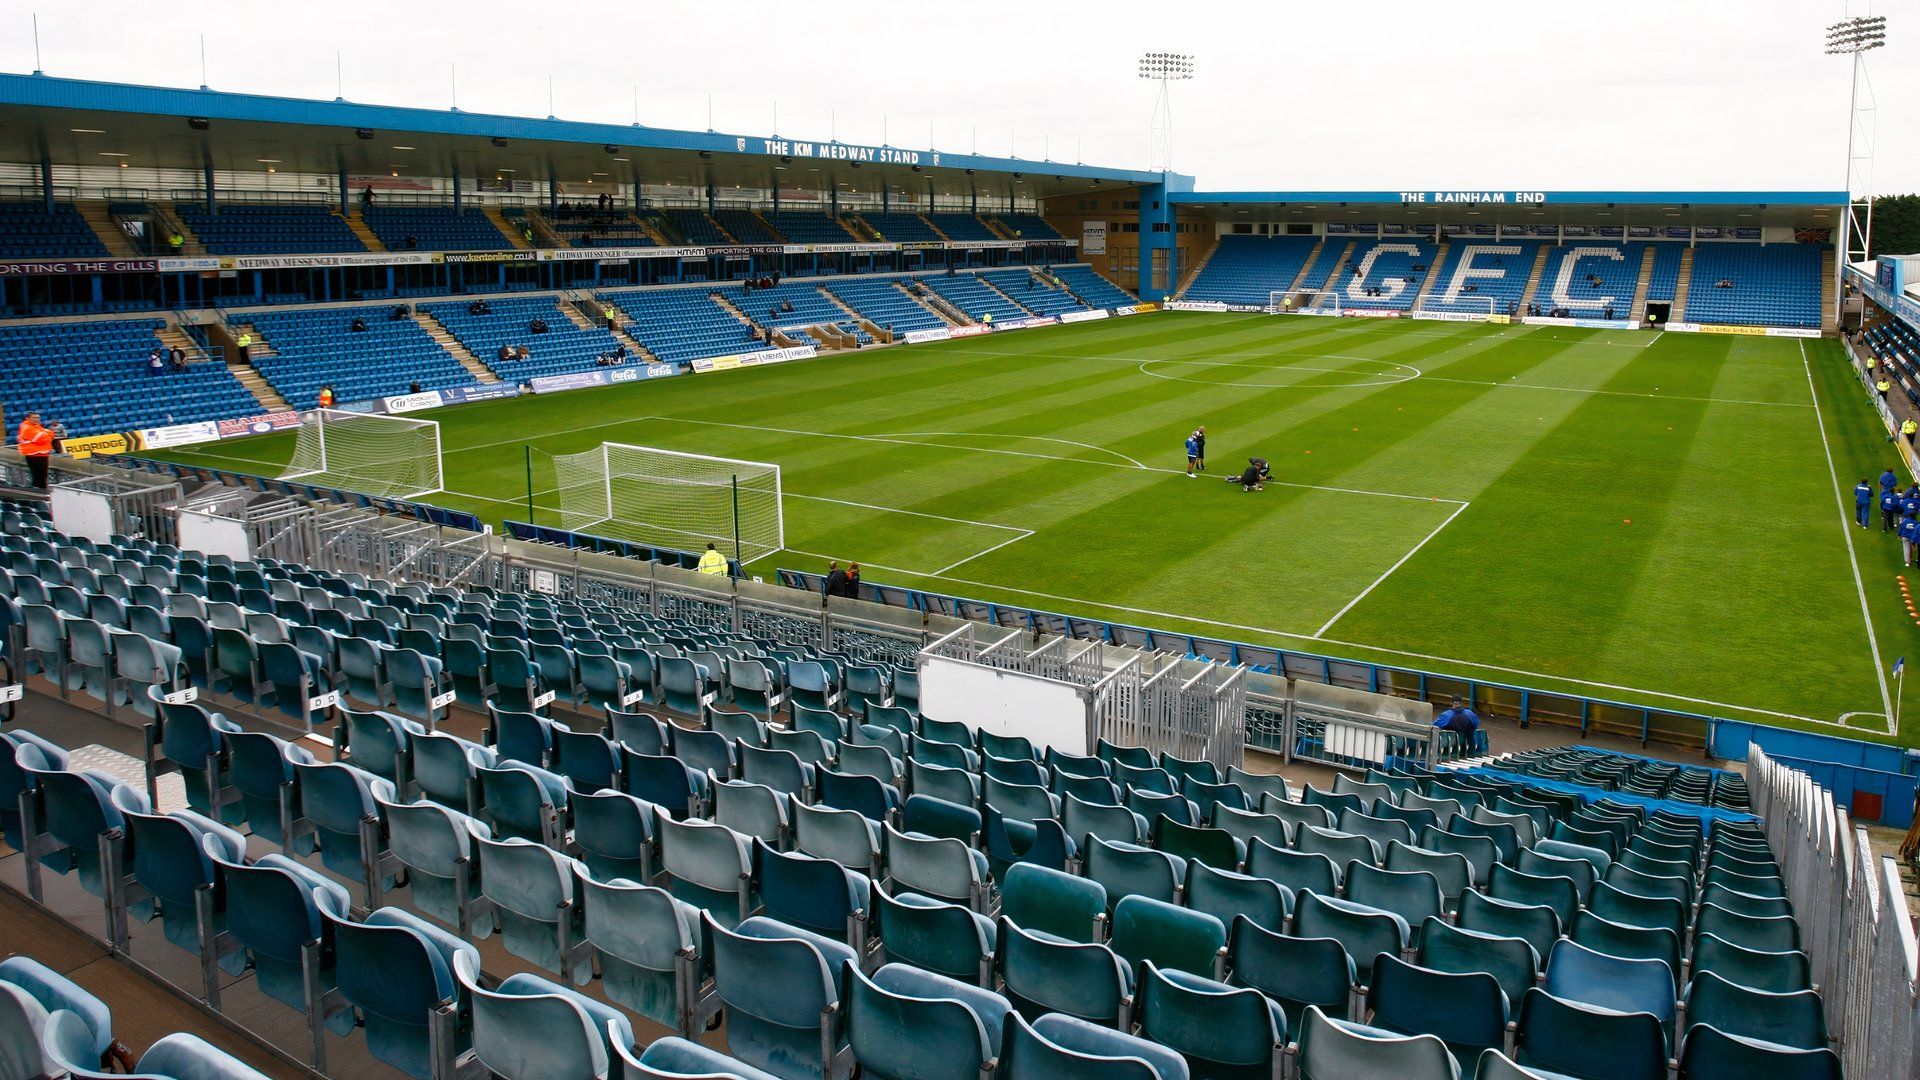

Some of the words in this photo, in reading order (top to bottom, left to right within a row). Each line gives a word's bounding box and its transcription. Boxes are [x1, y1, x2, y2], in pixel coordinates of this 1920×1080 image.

[765, 140, 788, 155] THE
[794, 142, 813, 156] KM
[820, 145, 875, 161] MEDWAY
[880, 150, 919, 164] STAND
[1400, 193, 1425, 202] THE
[1435, 193, 1505, 203] RAINHAM
[1516, 193, 1545, 203] END
[446, 252, 535, 263] www.kentonline.co.uk
[584, 250, 621, 258] MESSENGER
[0, 264, 67, 274] ORTING
[73, 262, 108, 272] THE
[114, 261, 155, 271] GILLS
[239, 259, 280, 267] MEDWAY
[283, 257, 339, 266] MESSENGER
[65, 439, 126, 453] RUDRIDGE
